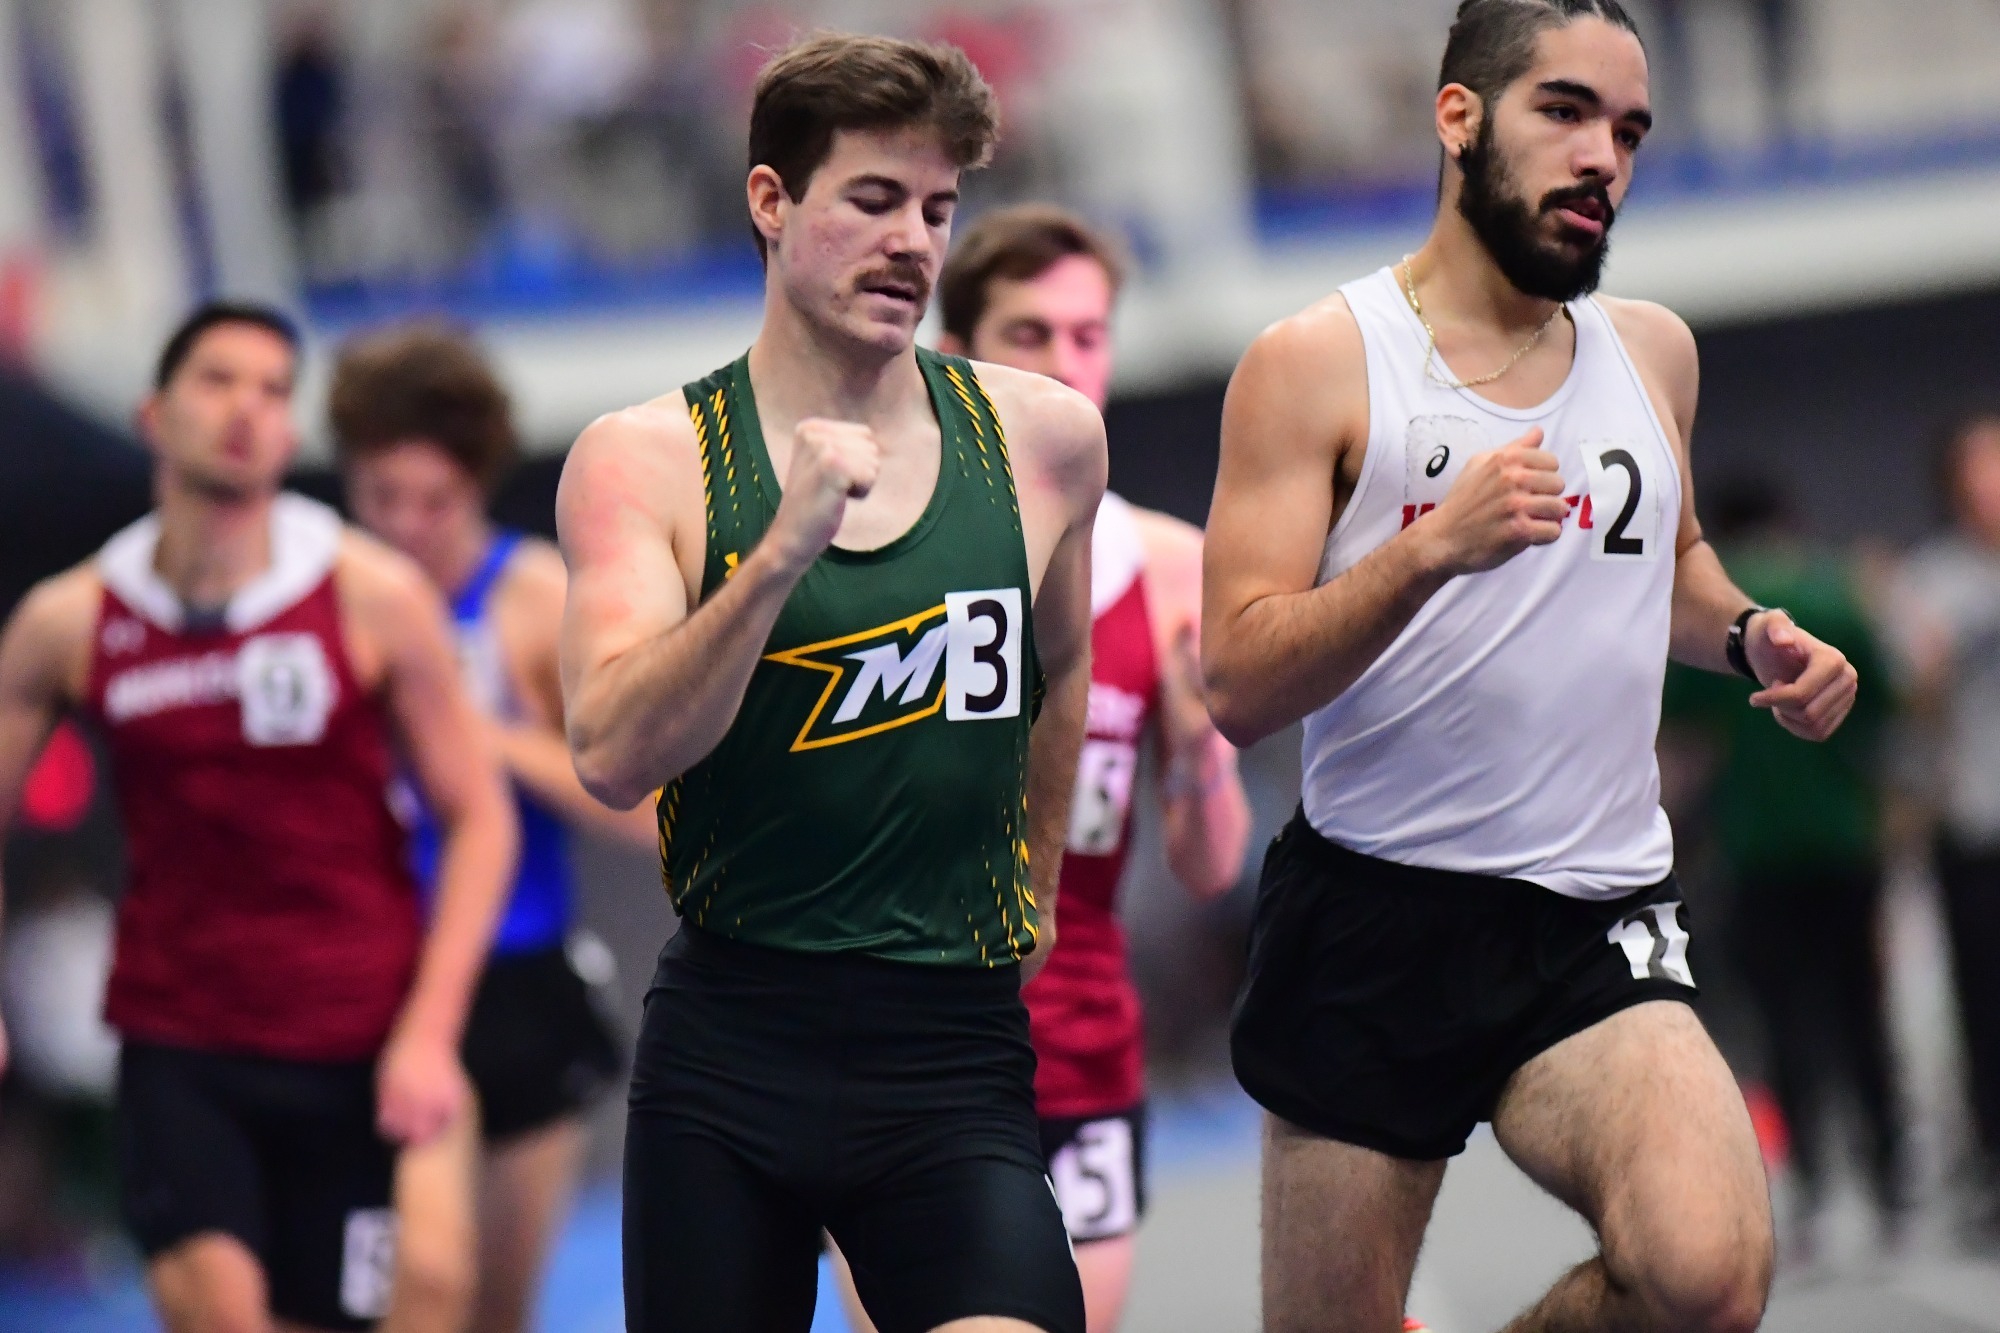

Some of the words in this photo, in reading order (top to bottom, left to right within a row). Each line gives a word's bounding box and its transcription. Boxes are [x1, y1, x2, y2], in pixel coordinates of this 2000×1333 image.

[1599, 448, 1643, 555] 2
[831, 622, 949, 725] M
[964, 599, 1009, 713] 3
[1077, 1137, 1114, 1223] 5
